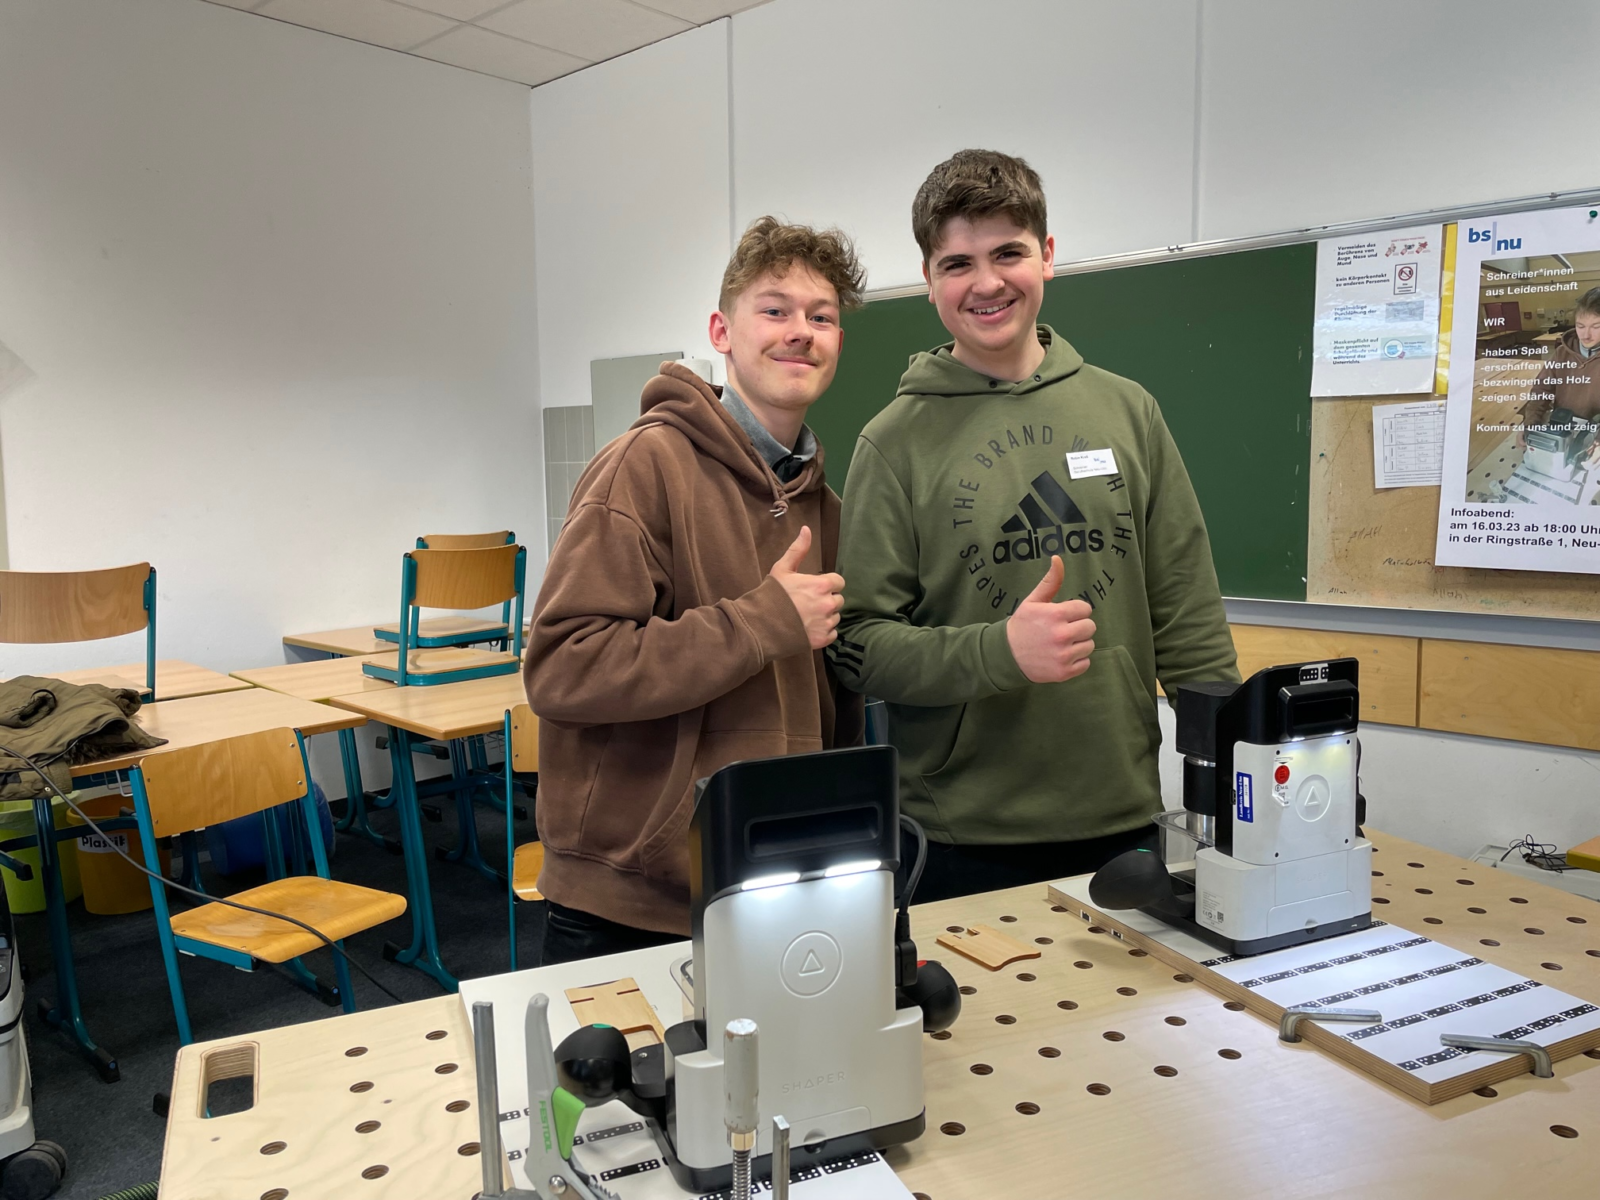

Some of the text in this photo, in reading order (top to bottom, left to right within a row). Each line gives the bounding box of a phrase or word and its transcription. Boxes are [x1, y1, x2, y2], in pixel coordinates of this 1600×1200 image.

[1468, 228, 1491, 243] bs
[1496, 238, 1522, 251] nu
[1485, 282, 1578, 297] aus Leidenschaft
[1483, 318, 1506, 327] WIR
[1481, 346, 1549, 357] -haben Spaß
[1480, 361, 1577, 372] -erschaffen Werte
[1479, 375, 1591, 388] -bezwingen das Holz
[1478, 392, 1555, 404] -zeigen Stärke
[1476, 422, 1597, 433] Komm zu uns und zeig
[974, 425, 1053, 469] BRAND
[953, 479, 980, 529] THE
[1450, 508, 1515, 519] Infoabend:
[1111, 510, 1132, 559] THE
[1450, 522, 1468, 531] am
[1471, 521, 1520, 532] 16.03.23
[1523, 523, 1539, 533] ab
[1543, 523, 1577, 534] 18:00
[993, 524, 1105, 565] adidas
[1449, 533, 1460, 543] in
[1463, 534, 1483, 543] der
[1486, 535, 1554, 547] Ringstraße
[1557, 538, 1568, 549] 1,
[959, 543, 1019, 616] TRIPES
[1069, 569, 1115, 610] THR
[81, 835, 126, 848] Plasik
[781, 1071, 845, 1094] SHAPER
[538, 1100, 552, 1154] FESTOOL
